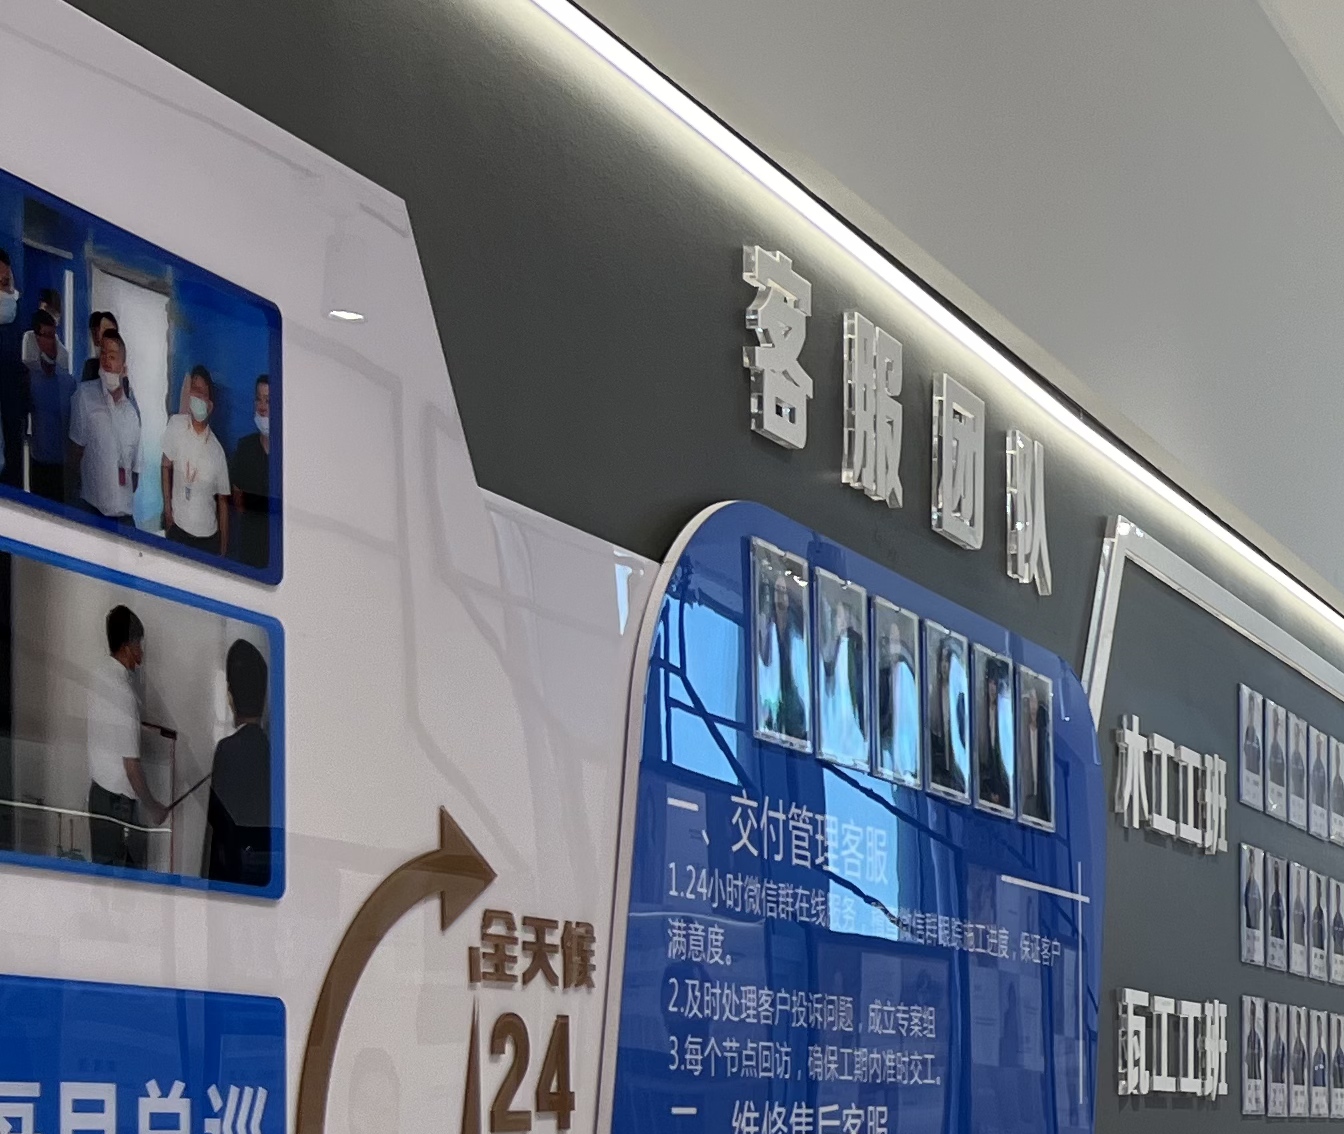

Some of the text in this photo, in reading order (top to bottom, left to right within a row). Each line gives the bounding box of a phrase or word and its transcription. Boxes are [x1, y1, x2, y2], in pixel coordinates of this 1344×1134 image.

[742, 245, 1052, 596] 客服团队
[470, 908, 596, 990] 全天候
[668, 918, 732, 967] 满意度。
[668, 977, 936, 1039] 2.及时处理客户投诉问题，成立专案组
[489, 1012, 576, 1134] 24
[668, 1034, 942, 1086] 3.每个节点回访，确保工期内准时交工。
